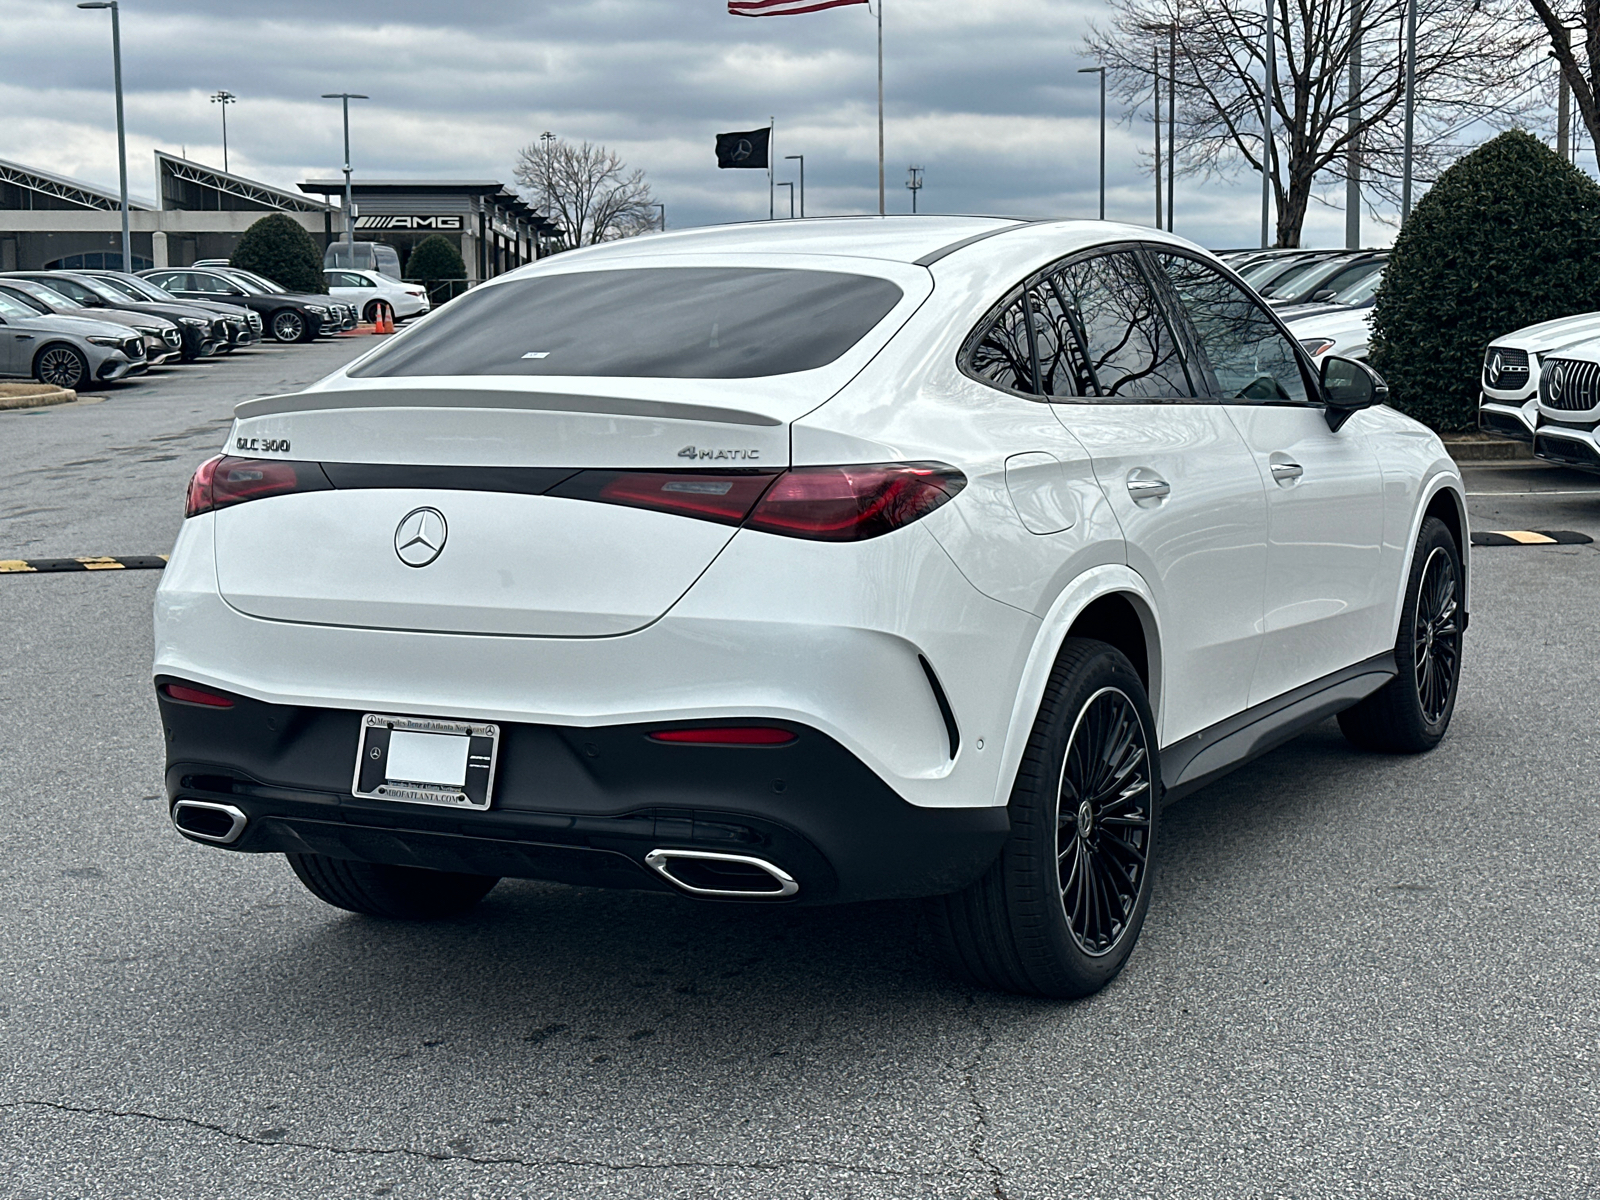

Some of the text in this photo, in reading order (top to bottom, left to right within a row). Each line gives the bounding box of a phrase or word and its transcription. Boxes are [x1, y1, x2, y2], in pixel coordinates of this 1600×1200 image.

[236, 437, 291, 452] GLC 300
[677, 444, 760, 460] 4MATIC
